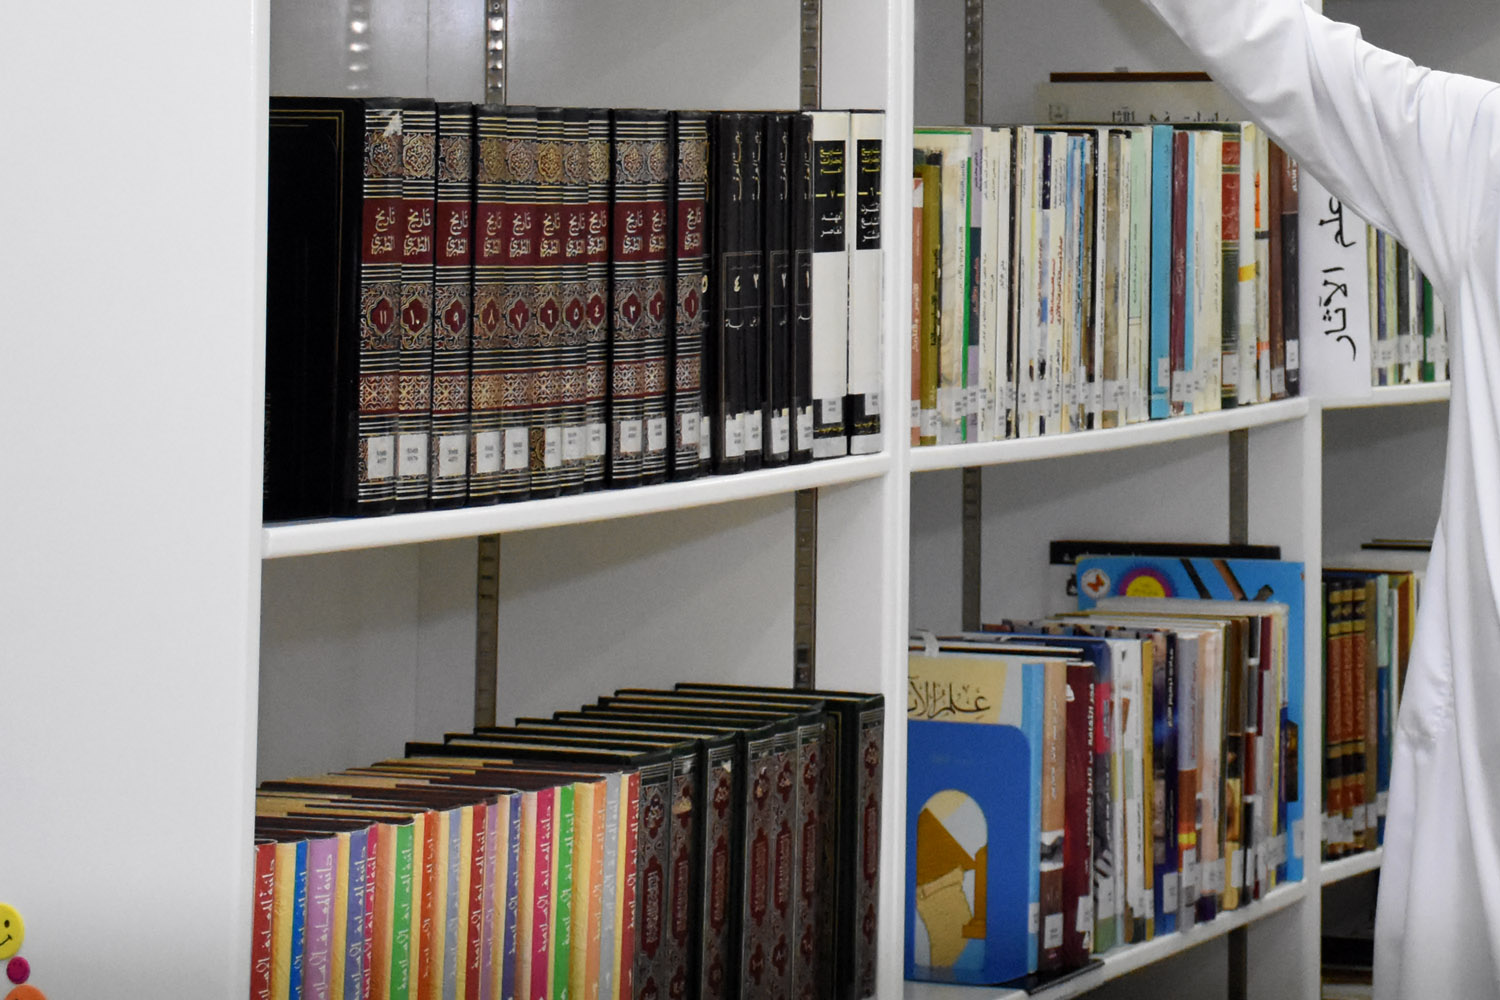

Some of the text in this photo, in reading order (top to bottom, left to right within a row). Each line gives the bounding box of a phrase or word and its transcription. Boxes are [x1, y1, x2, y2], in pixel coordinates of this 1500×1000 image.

[375, 207, 396, 232] تاريخ
[407, 208, 431, 233] تاريخ
[449, 211, 469, 236] تاريخ
[512, 211, 532, 236] تاريخ
[589, 210, 607, 234] تاريخ
[626, 210, 643, 234] تاريخ
[379, 310, 387, 324] ١١
[410, 310, 420, 325] ١٠
[453, 311, 460, 326] ٩
[487, 309, 495, 325] ٨
[515, 312, 523, 328] ٧
[547, 309, 553, 323] ٦
[573, 308, 579, 320] ٥
[594, 306, 601, 318] ٤
[629, 305, 636, 319] ٣
